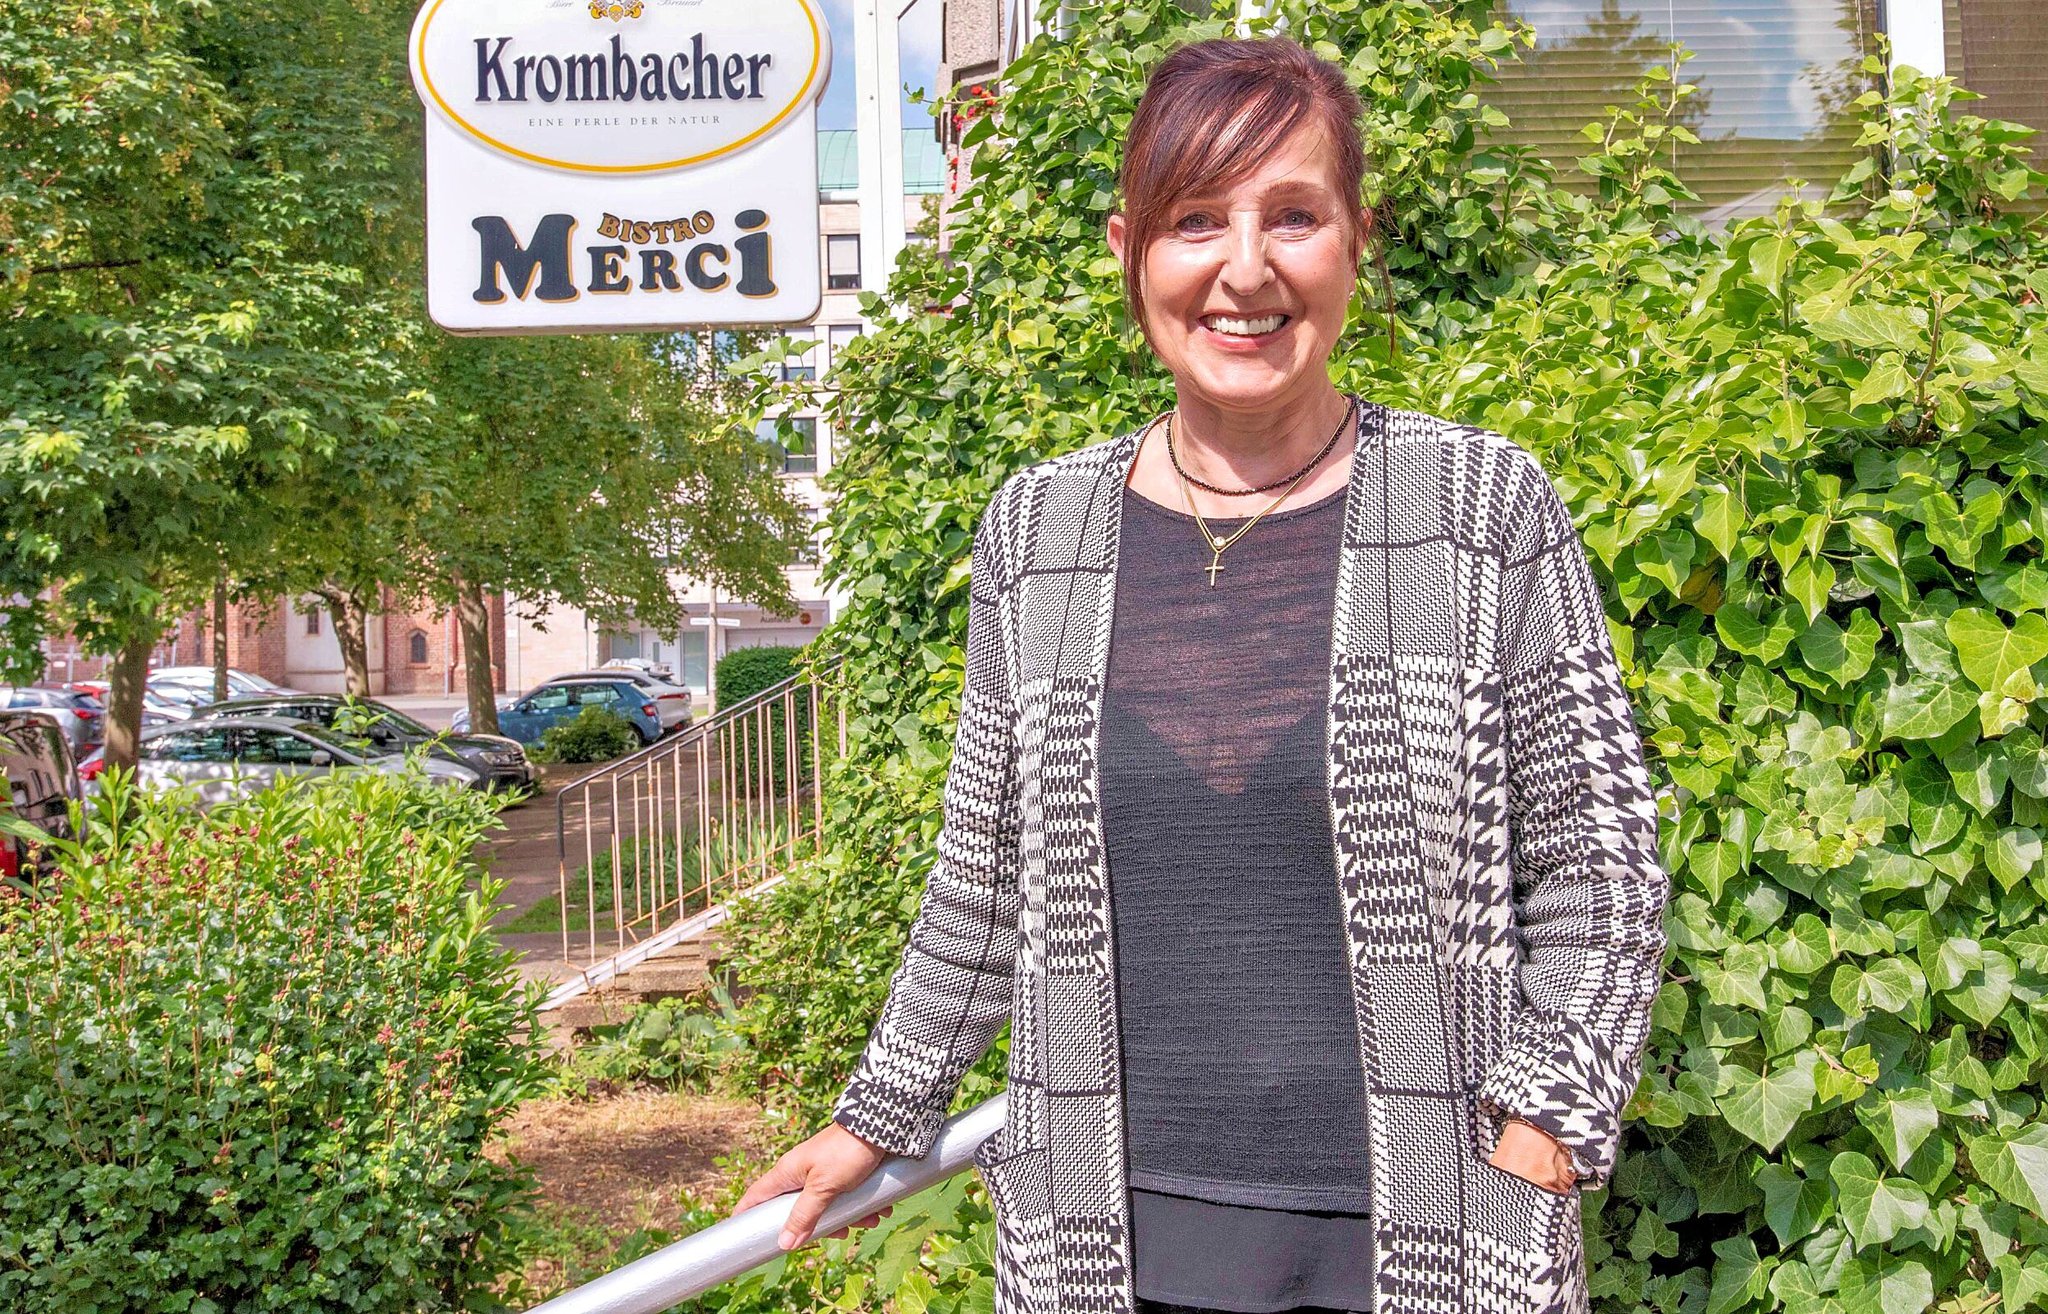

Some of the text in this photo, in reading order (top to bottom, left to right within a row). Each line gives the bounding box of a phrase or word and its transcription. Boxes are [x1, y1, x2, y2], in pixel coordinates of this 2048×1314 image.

[473, 31, 772, 102] Krombacher
[528, 115, 721, 127] EINE PERLE DER NATUR
[597, 209, 716, 245] BISTRO
